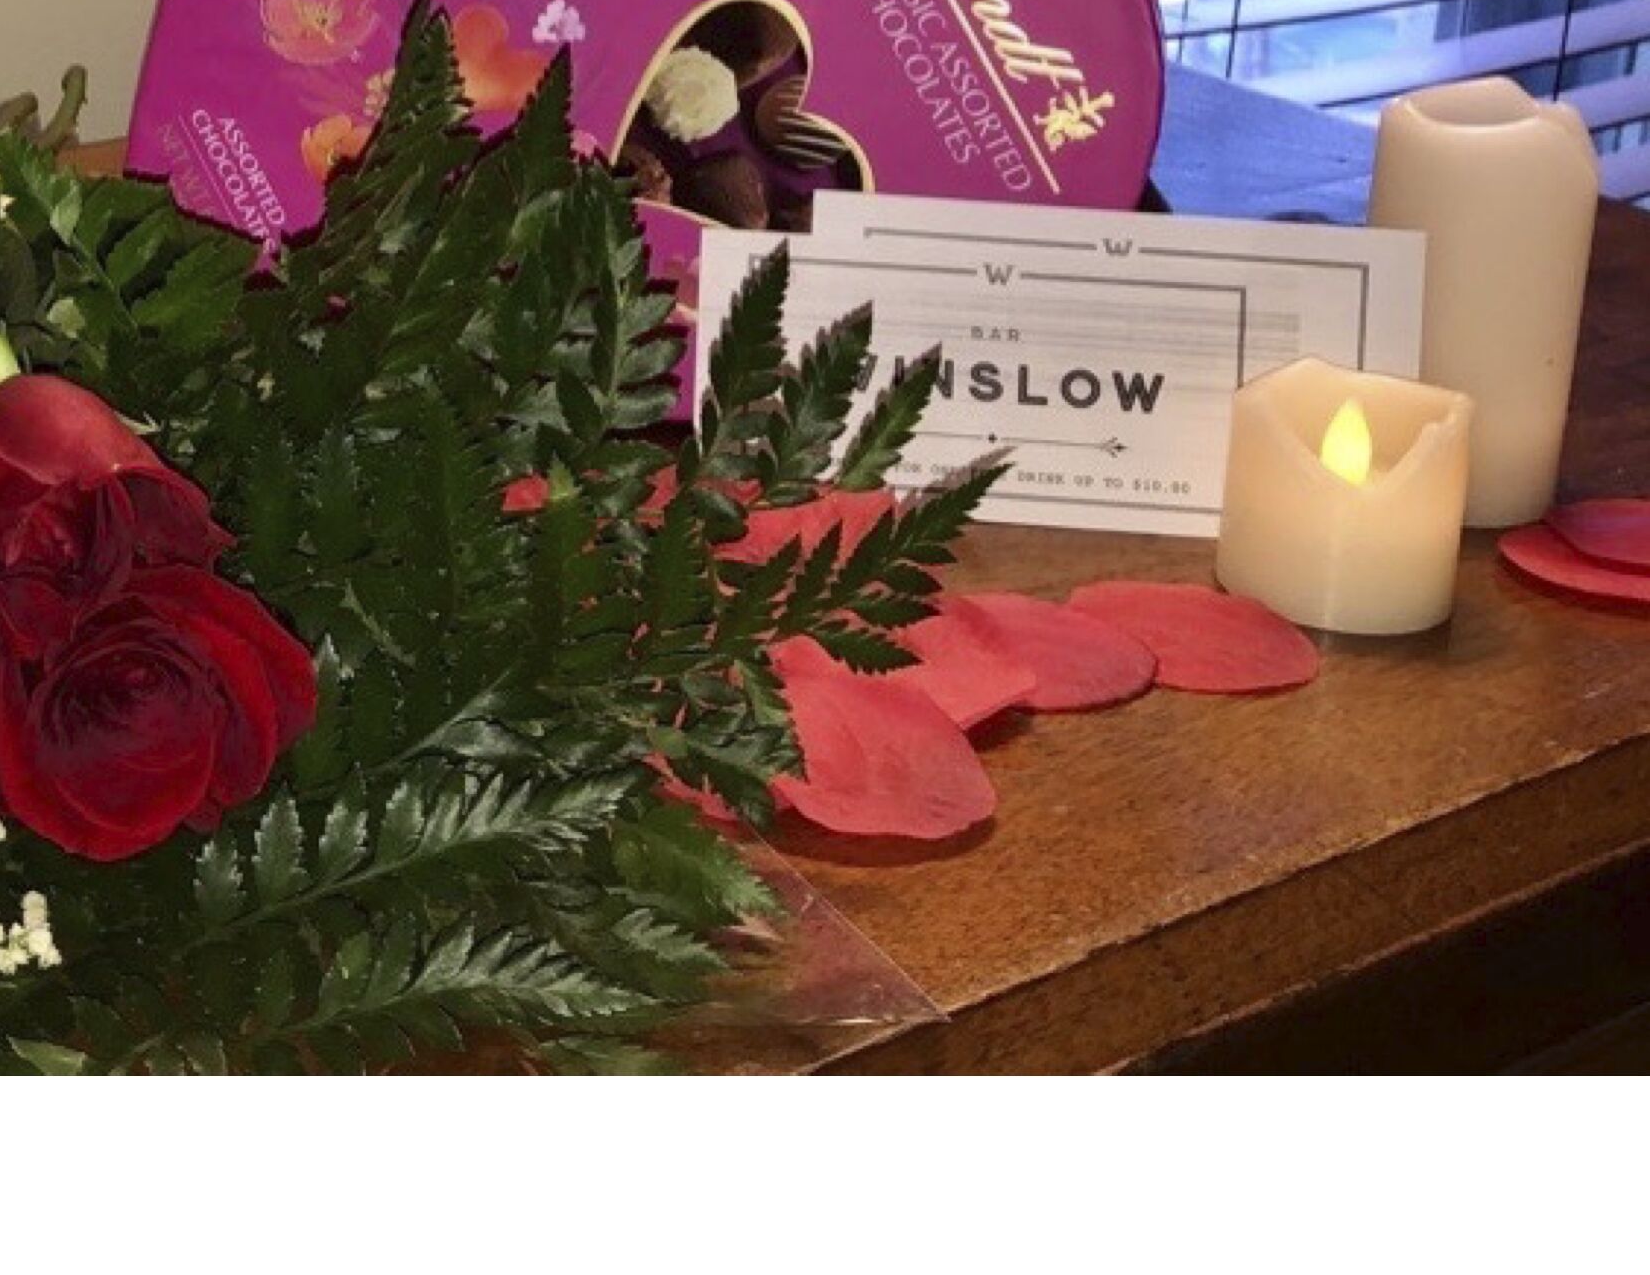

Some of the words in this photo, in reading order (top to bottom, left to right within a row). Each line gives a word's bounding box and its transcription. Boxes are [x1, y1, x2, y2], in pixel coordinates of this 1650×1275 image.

[930, 41, 1031, 190] ASSORTED
[217, 117, 285, 224] ASSORTED
[983, 262, 1015, 286] W
[970, 325, 1021, 342] BAR
[1103, 477, 1123, 489] TO
